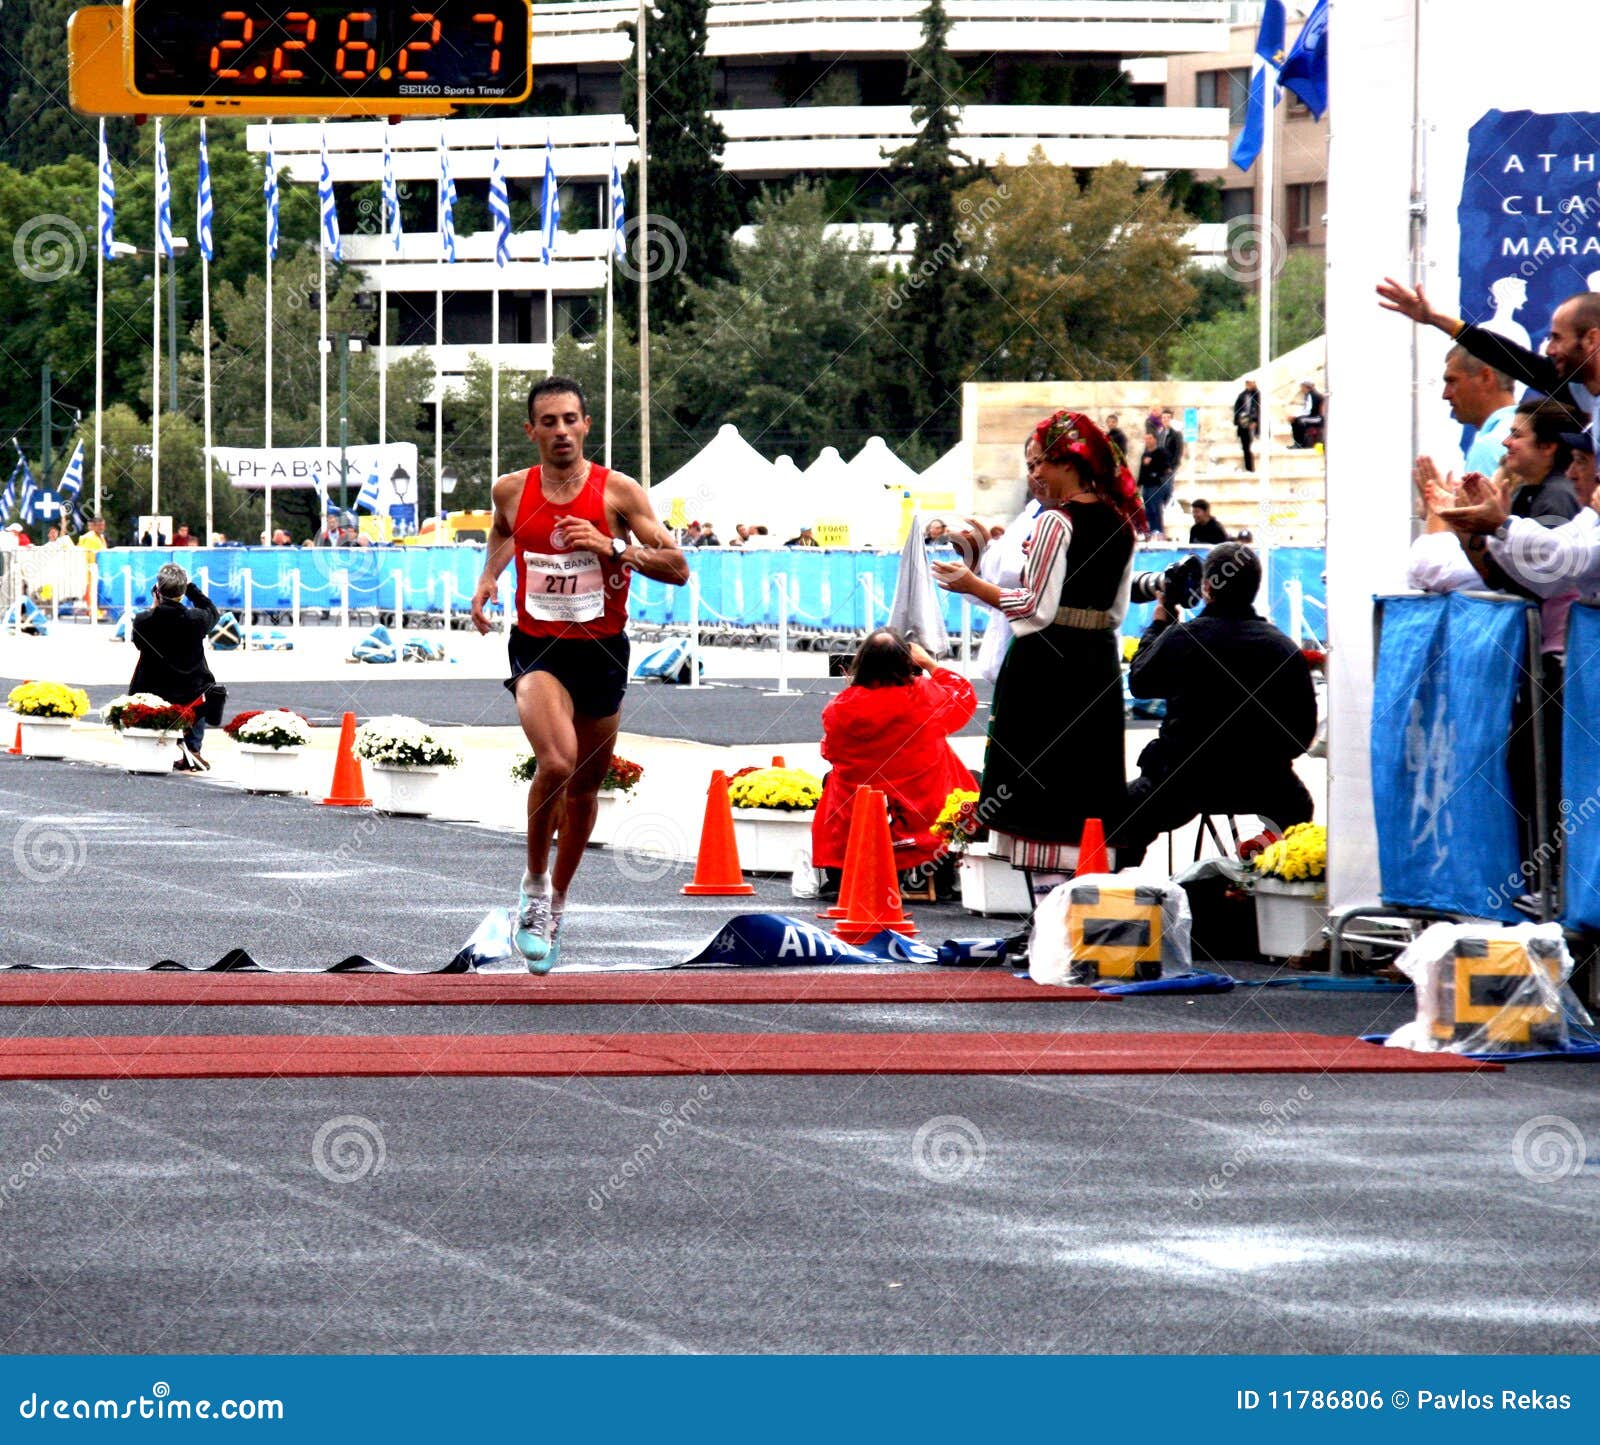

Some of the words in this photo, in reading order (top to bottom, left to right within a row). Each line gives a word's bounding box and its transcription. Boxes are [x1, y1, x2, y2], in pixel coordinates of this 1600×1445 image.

[399, 84, 441, 95] SEIKO
[443, 85, 475, 95] Sports
[477, 85, 506, 95] Timer
[1503, 154, 1595, 173] ATH
[1501, 195, 1588, 215] CLA
[1502, 236, 1600, 256] MARA
[530, 559, 562, 570] ALPHA
[564, 558, 597, 569] BANK
[545, 575, 578, 594] 277
